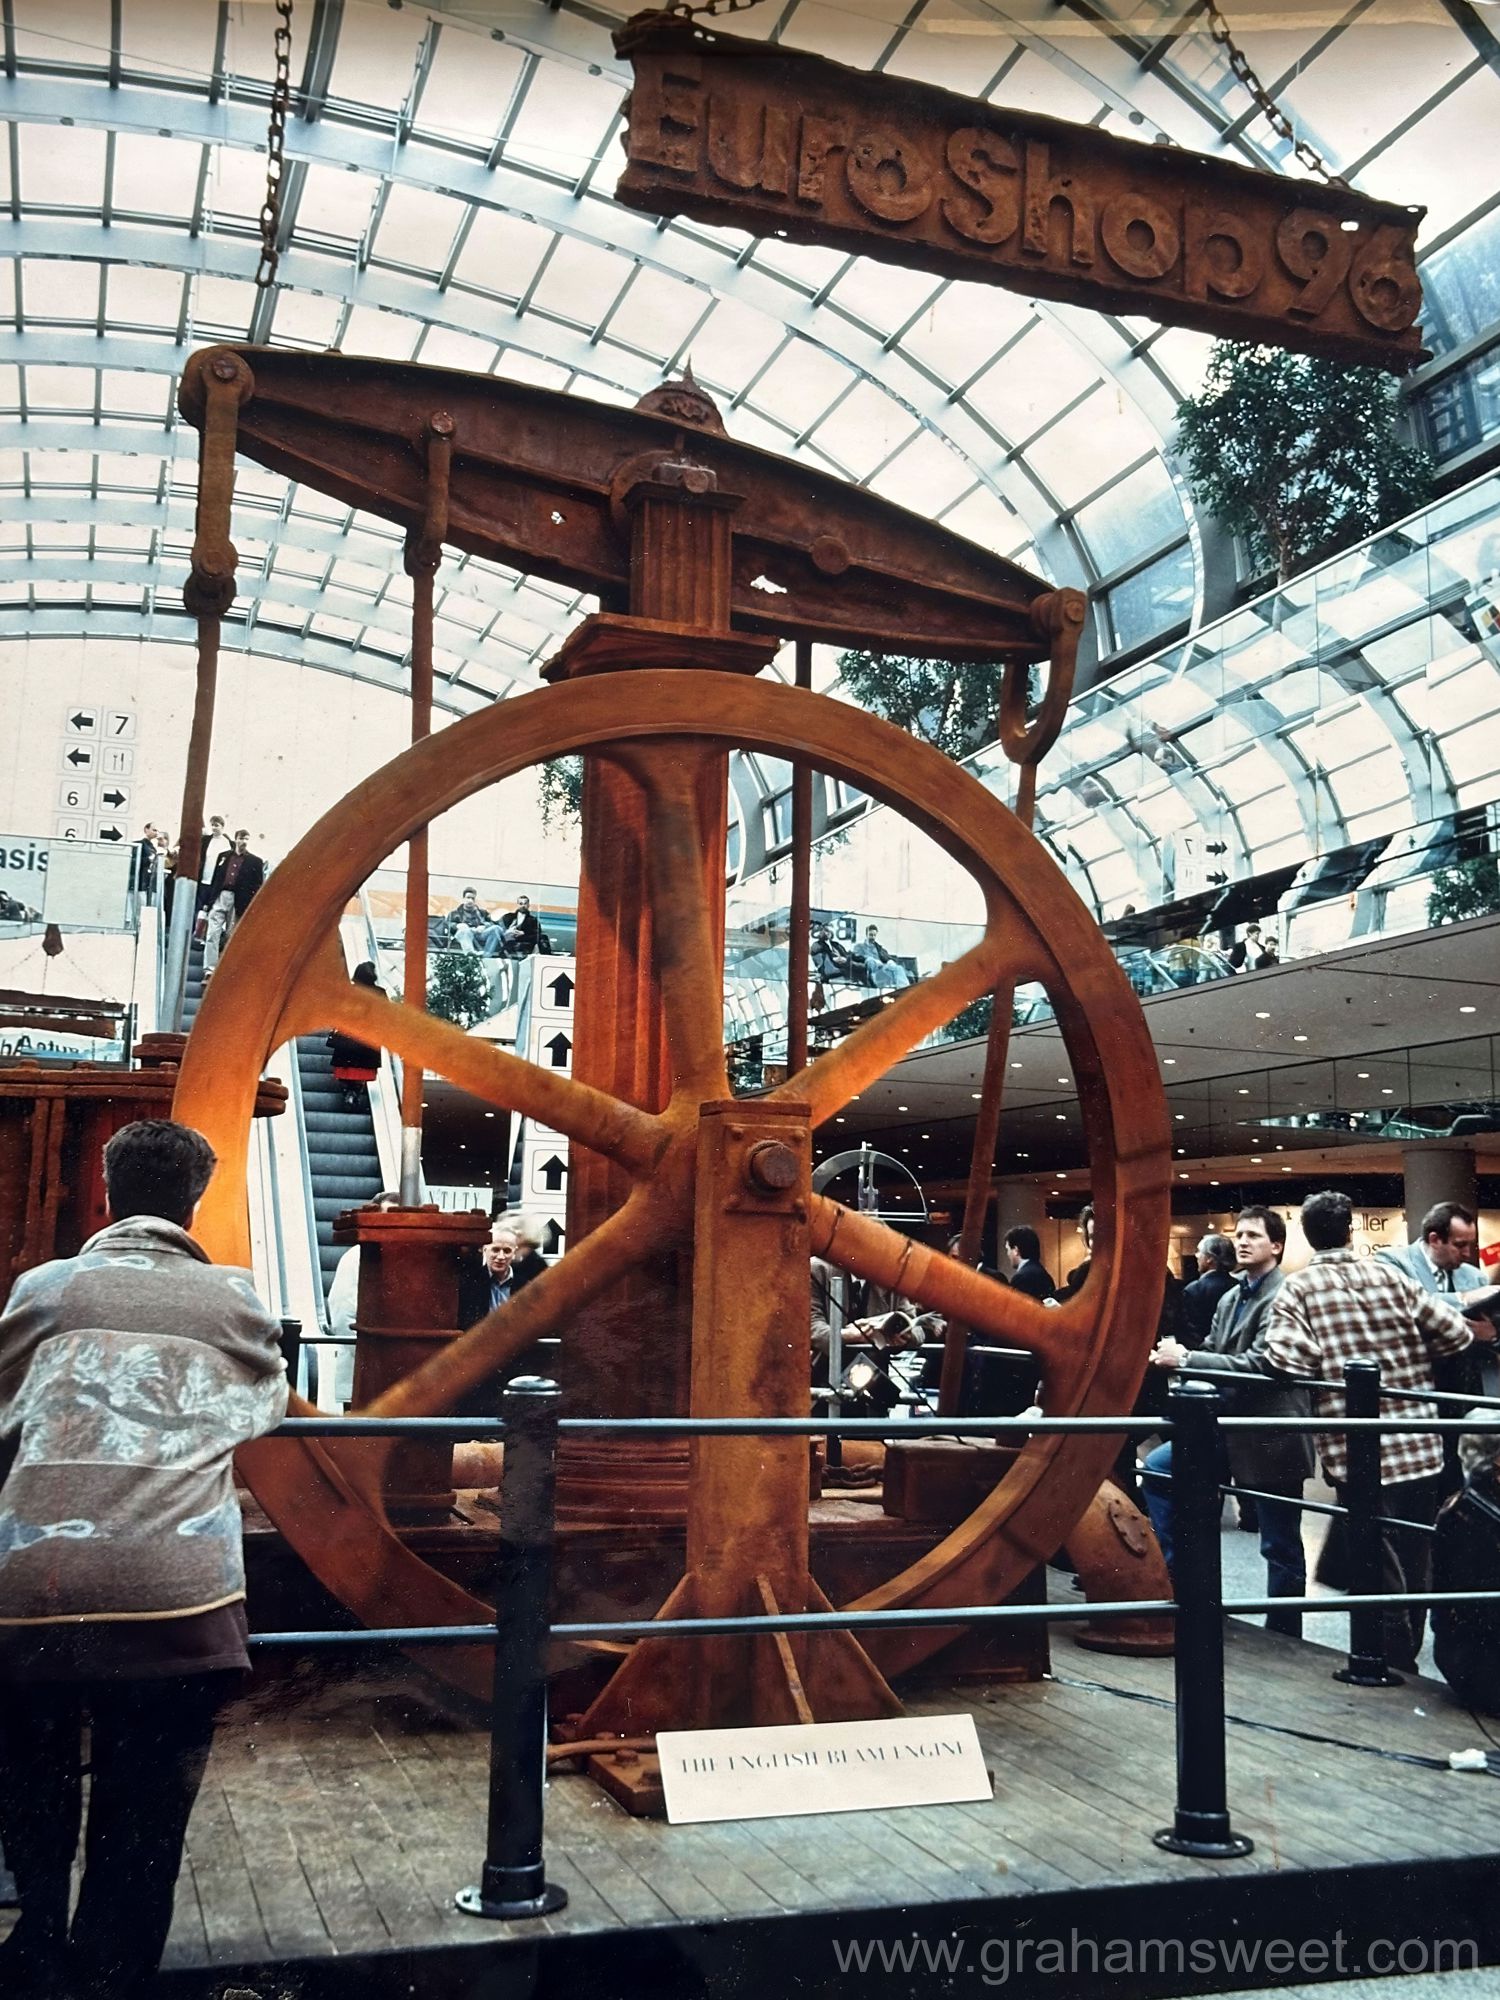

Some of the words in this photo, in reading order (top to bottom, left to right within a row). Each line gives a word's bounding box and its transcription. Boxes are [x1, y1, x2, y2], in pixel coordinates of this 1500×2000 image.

[630, 53, 1422, 332] EuroShop96
[115, 715, 129, 735] 7
[67, 791, 79, 806] 6
[681, 1757, 716, 1773] THE
[728, 1751, 819, 1771] ENGLISH
[827, 1749, 886, 1764] BEAM
[893, 1741, 964, 1760] ENGINE
